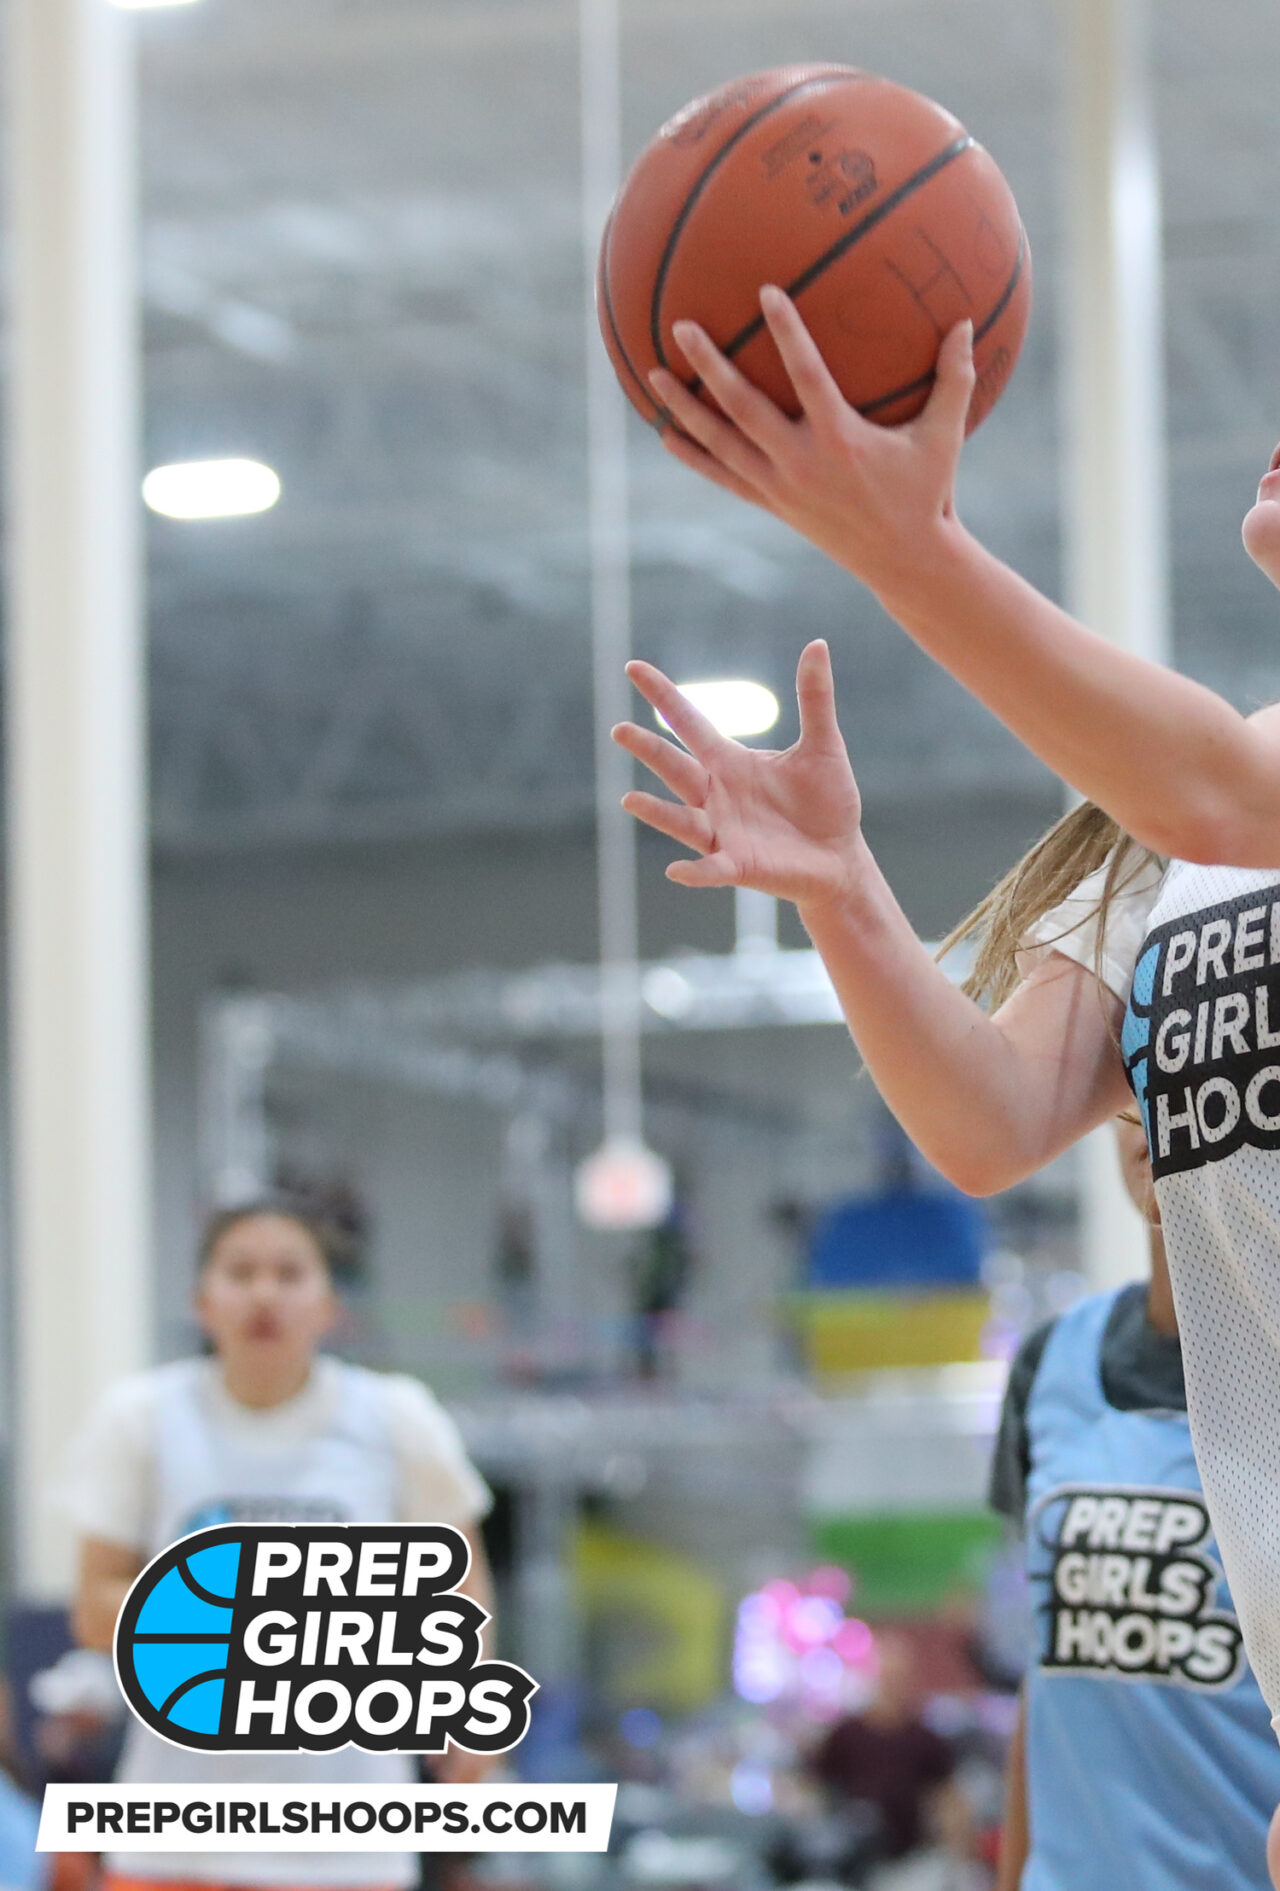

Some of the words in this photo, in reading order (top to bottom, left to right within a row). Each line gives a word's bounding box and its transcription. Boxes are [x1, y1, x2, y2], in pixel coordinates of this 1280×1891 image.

[1060, 1496, 1206, 1552] PREP
[1056, 1553, 1206, 1617] GIRLS
[1055, 1609, 1234, 1678] HOOPS
